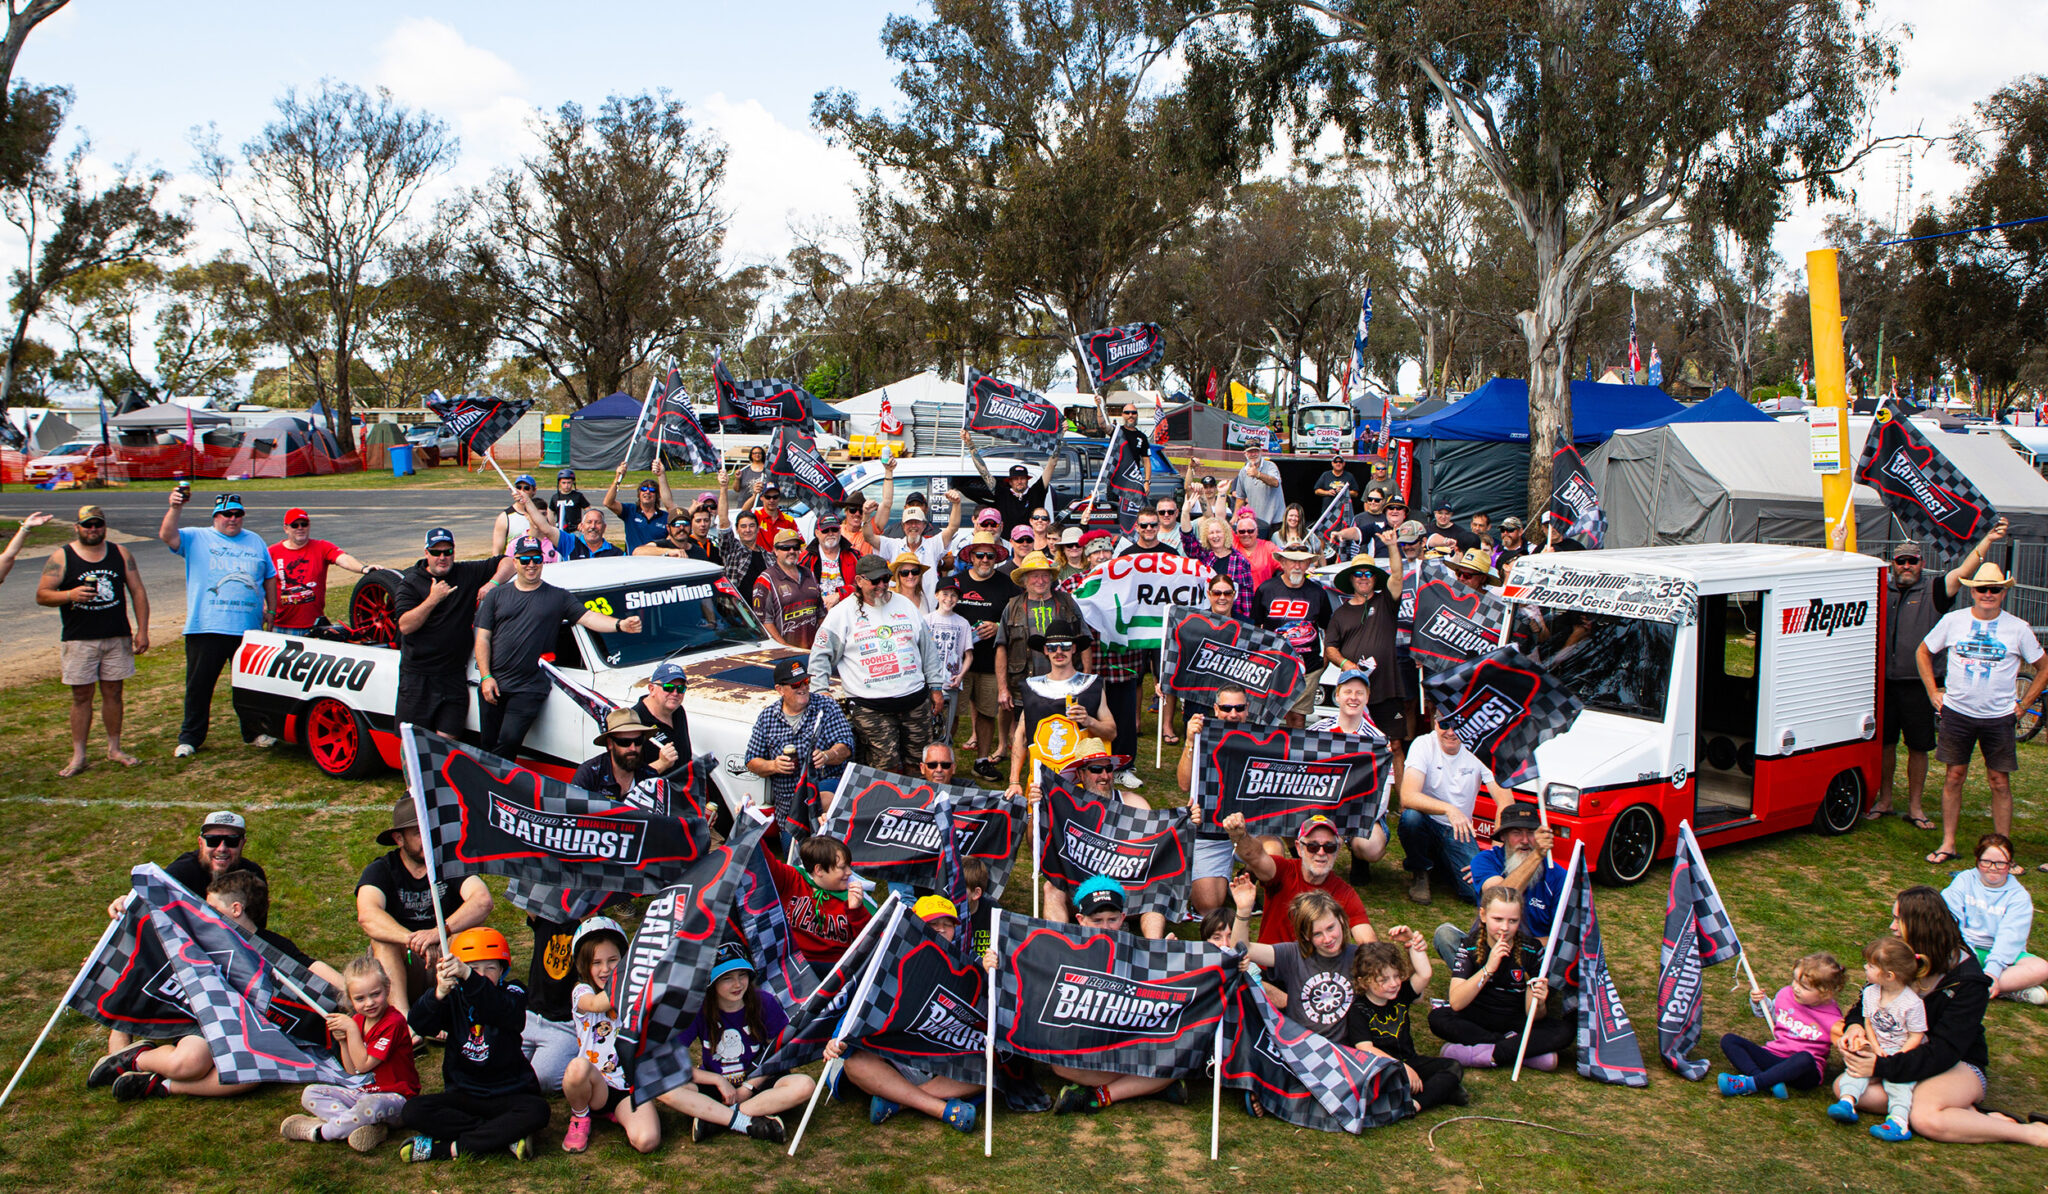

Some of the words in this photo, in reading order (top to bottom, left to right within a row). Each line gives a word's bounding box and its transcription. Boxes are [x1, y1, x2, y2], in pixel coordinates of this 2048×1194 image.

[989, 399, 1041, 427] BATHURST
[1240, 425, 1269, 437] Castrol
[1316, 428, 1341, 437] Castrol
[786, 448, 829, 489] BATHURST
[1889, 451, 1949, 517] BATHURST
[625, 583, 714, 610] ShowTime
[1556, 571, 1631, 590] ShowTime
[1656, 581, 1686, 599] 33
[584, 597, 614, 616] 33
[1267, 599, 1310, 619] 99
[1526, 586, 1579, 605] Repco
[1581, 595, 1612, 610] Gets
[1612, 601, 1640, 613] you
[1637, 604, 1675, 617] goin'
[1802, 597, 1869, 638] Repco
[1428, 613, 1499, 656] BATHURS
[266, 639, 376, 693] Repco
[860, 653, 897, 666] TOOHEYS
[1195, 648, 1273, 688] BATHURST
[1246, 768, 1342, 798] BATHURST
[1672, 767, 1686, 786] 33
[494, 803, 635, 860] BATHURST
[518, 809, 560, 828] Repco
[1065, 831, 1148, 879] BATHURST
[1085, 975, 1125, 992] Repco
[1135, 987, 1171, 1000] BRINGIN'
[1170, 991, 1188, 1002] THE
[1053, 982, 1183, 1029] BATHURST
[1776, 1007, 1823, 1041] Happy
